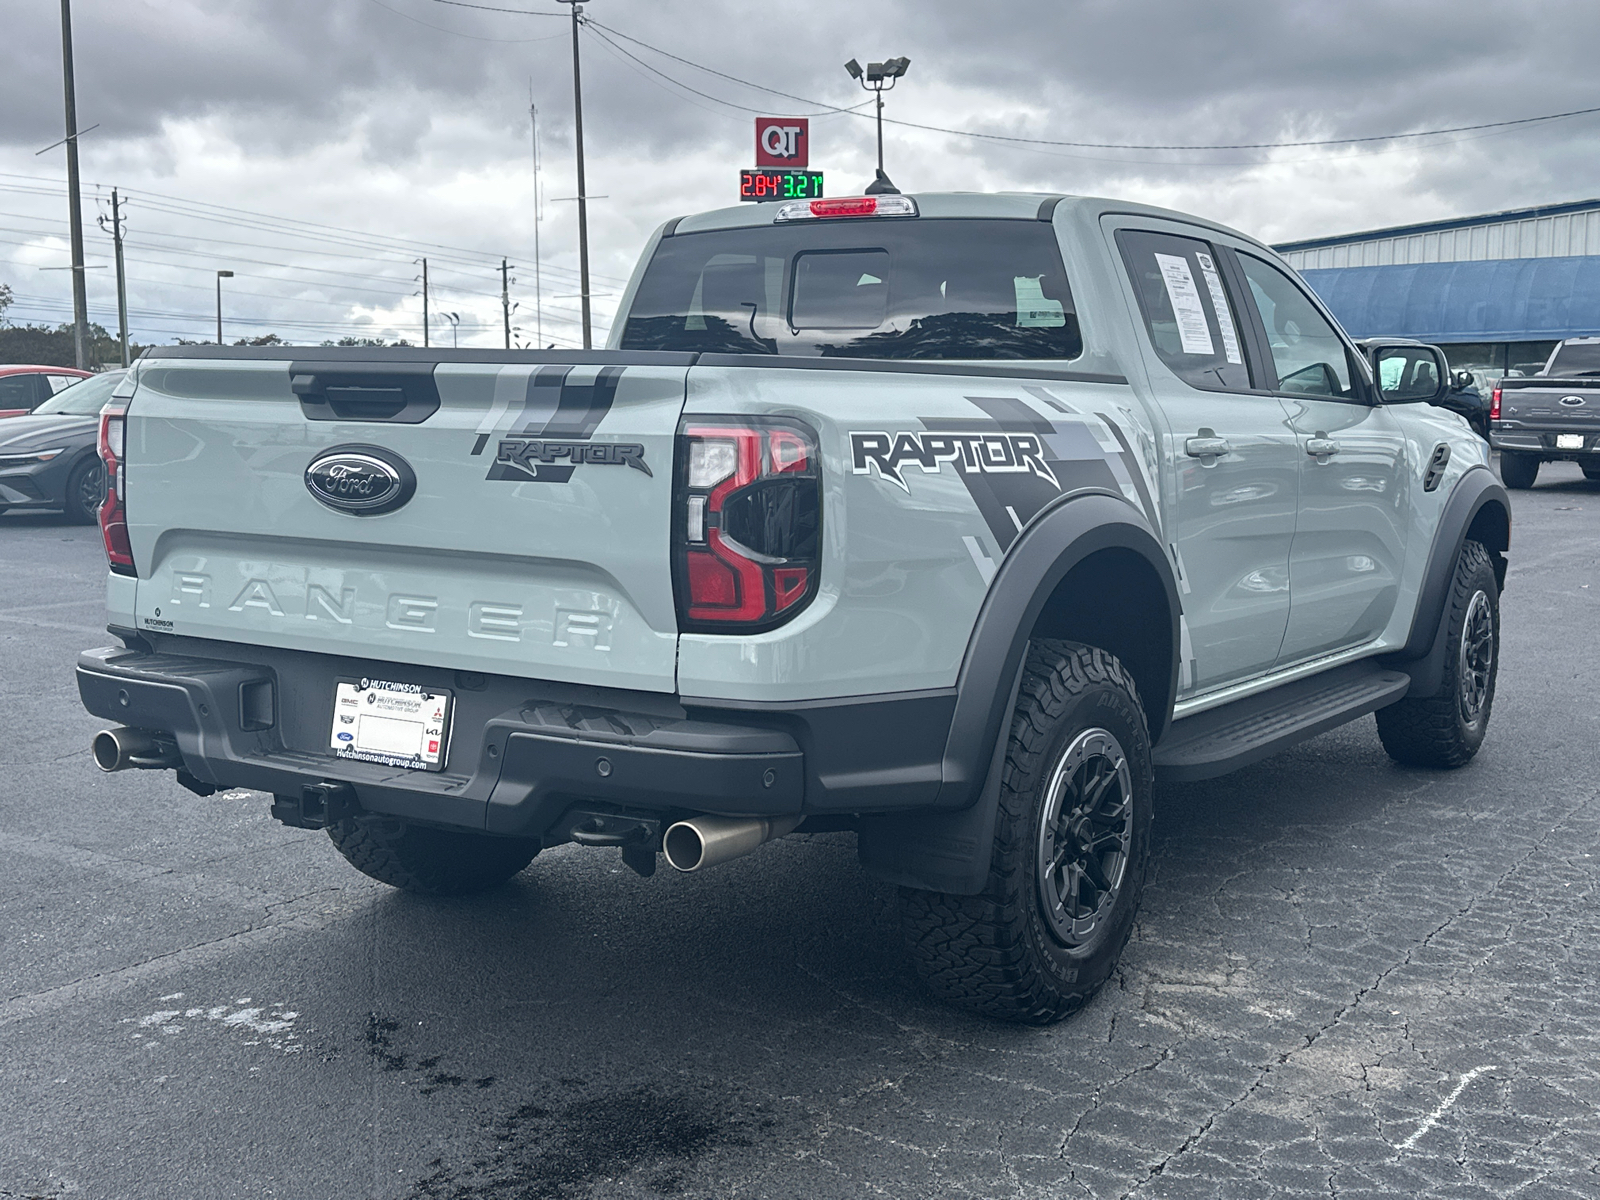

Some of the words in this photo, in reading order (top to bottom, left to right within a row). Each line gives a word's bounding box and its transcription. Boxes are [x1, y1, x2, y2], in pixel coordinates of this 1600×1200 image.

[761, 125, 801, 158] QT
[496, 439, 653, 478] RAPTOR
[848, 430, 1062, 496] RAPTOR
[325, 464, 375, 494] Ford
[169, 569, 612, 652] RANGER
[369, 679, 422, 694] HUTCHINSON
[336, 748, 427, 770] Hutchinsonautogroup.com
